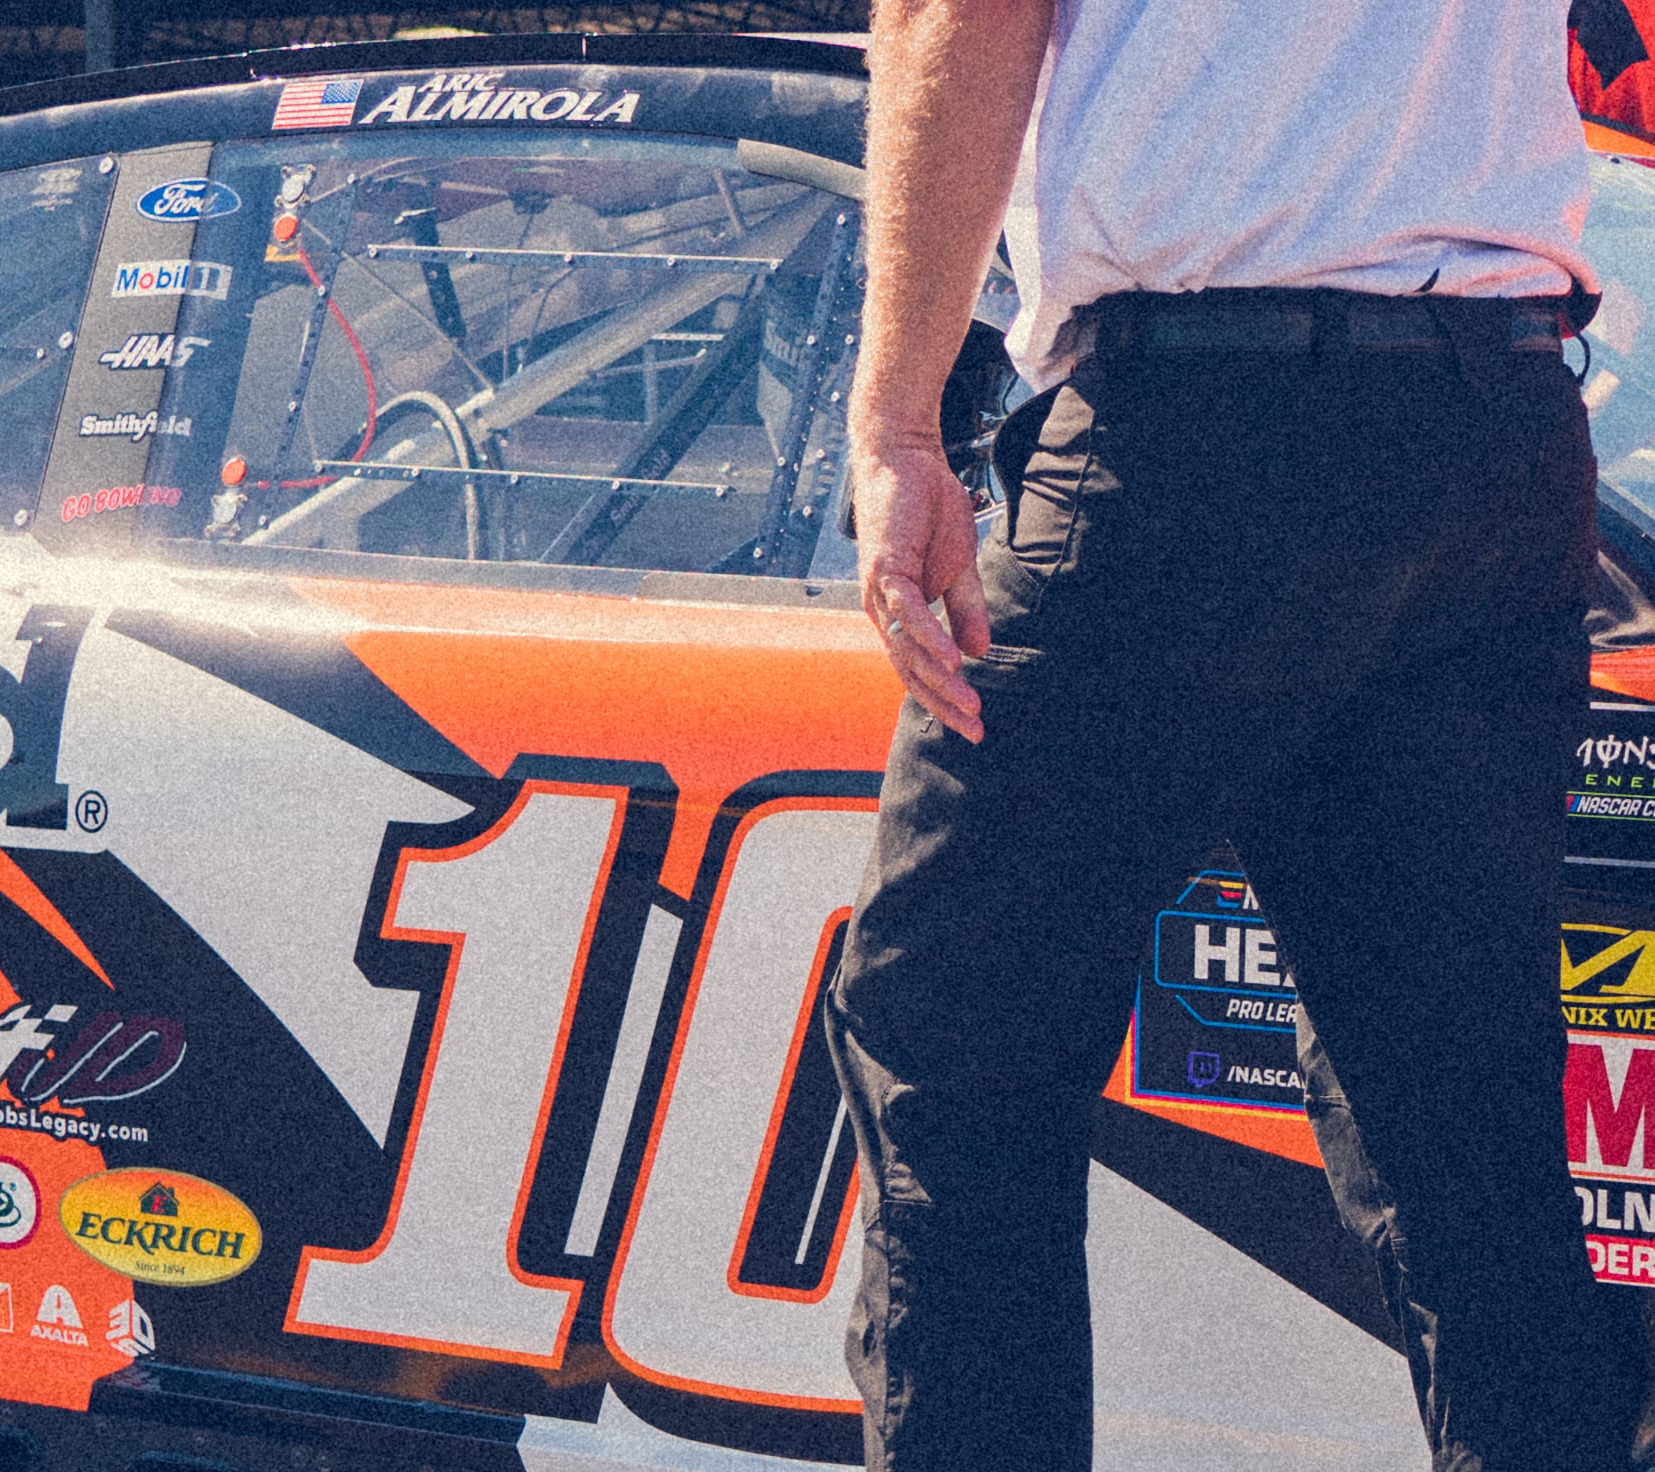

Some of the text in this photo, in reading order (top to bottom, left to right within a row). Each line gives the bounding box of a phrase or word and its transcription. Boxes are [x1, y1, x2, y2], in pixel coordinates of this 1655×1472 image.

[418, 72, 505, 96] ARIC
[357, 87, 641, 127] ALMIROLA
[116, 264, 189, 292] Mobil
[1577, 796, 1640, 817] NASCAR
[1194, 924, 1296, 987] HE
[1226, 998, 1264, 1021] PRO
[1227, 1065, 1308, 1090] /NASCA
[75, 1211, 246, 1260] ECKRICH
[135, 1260, 186, 1276] Since 1894
[30, 1324, 89, 1348] AXALTA
